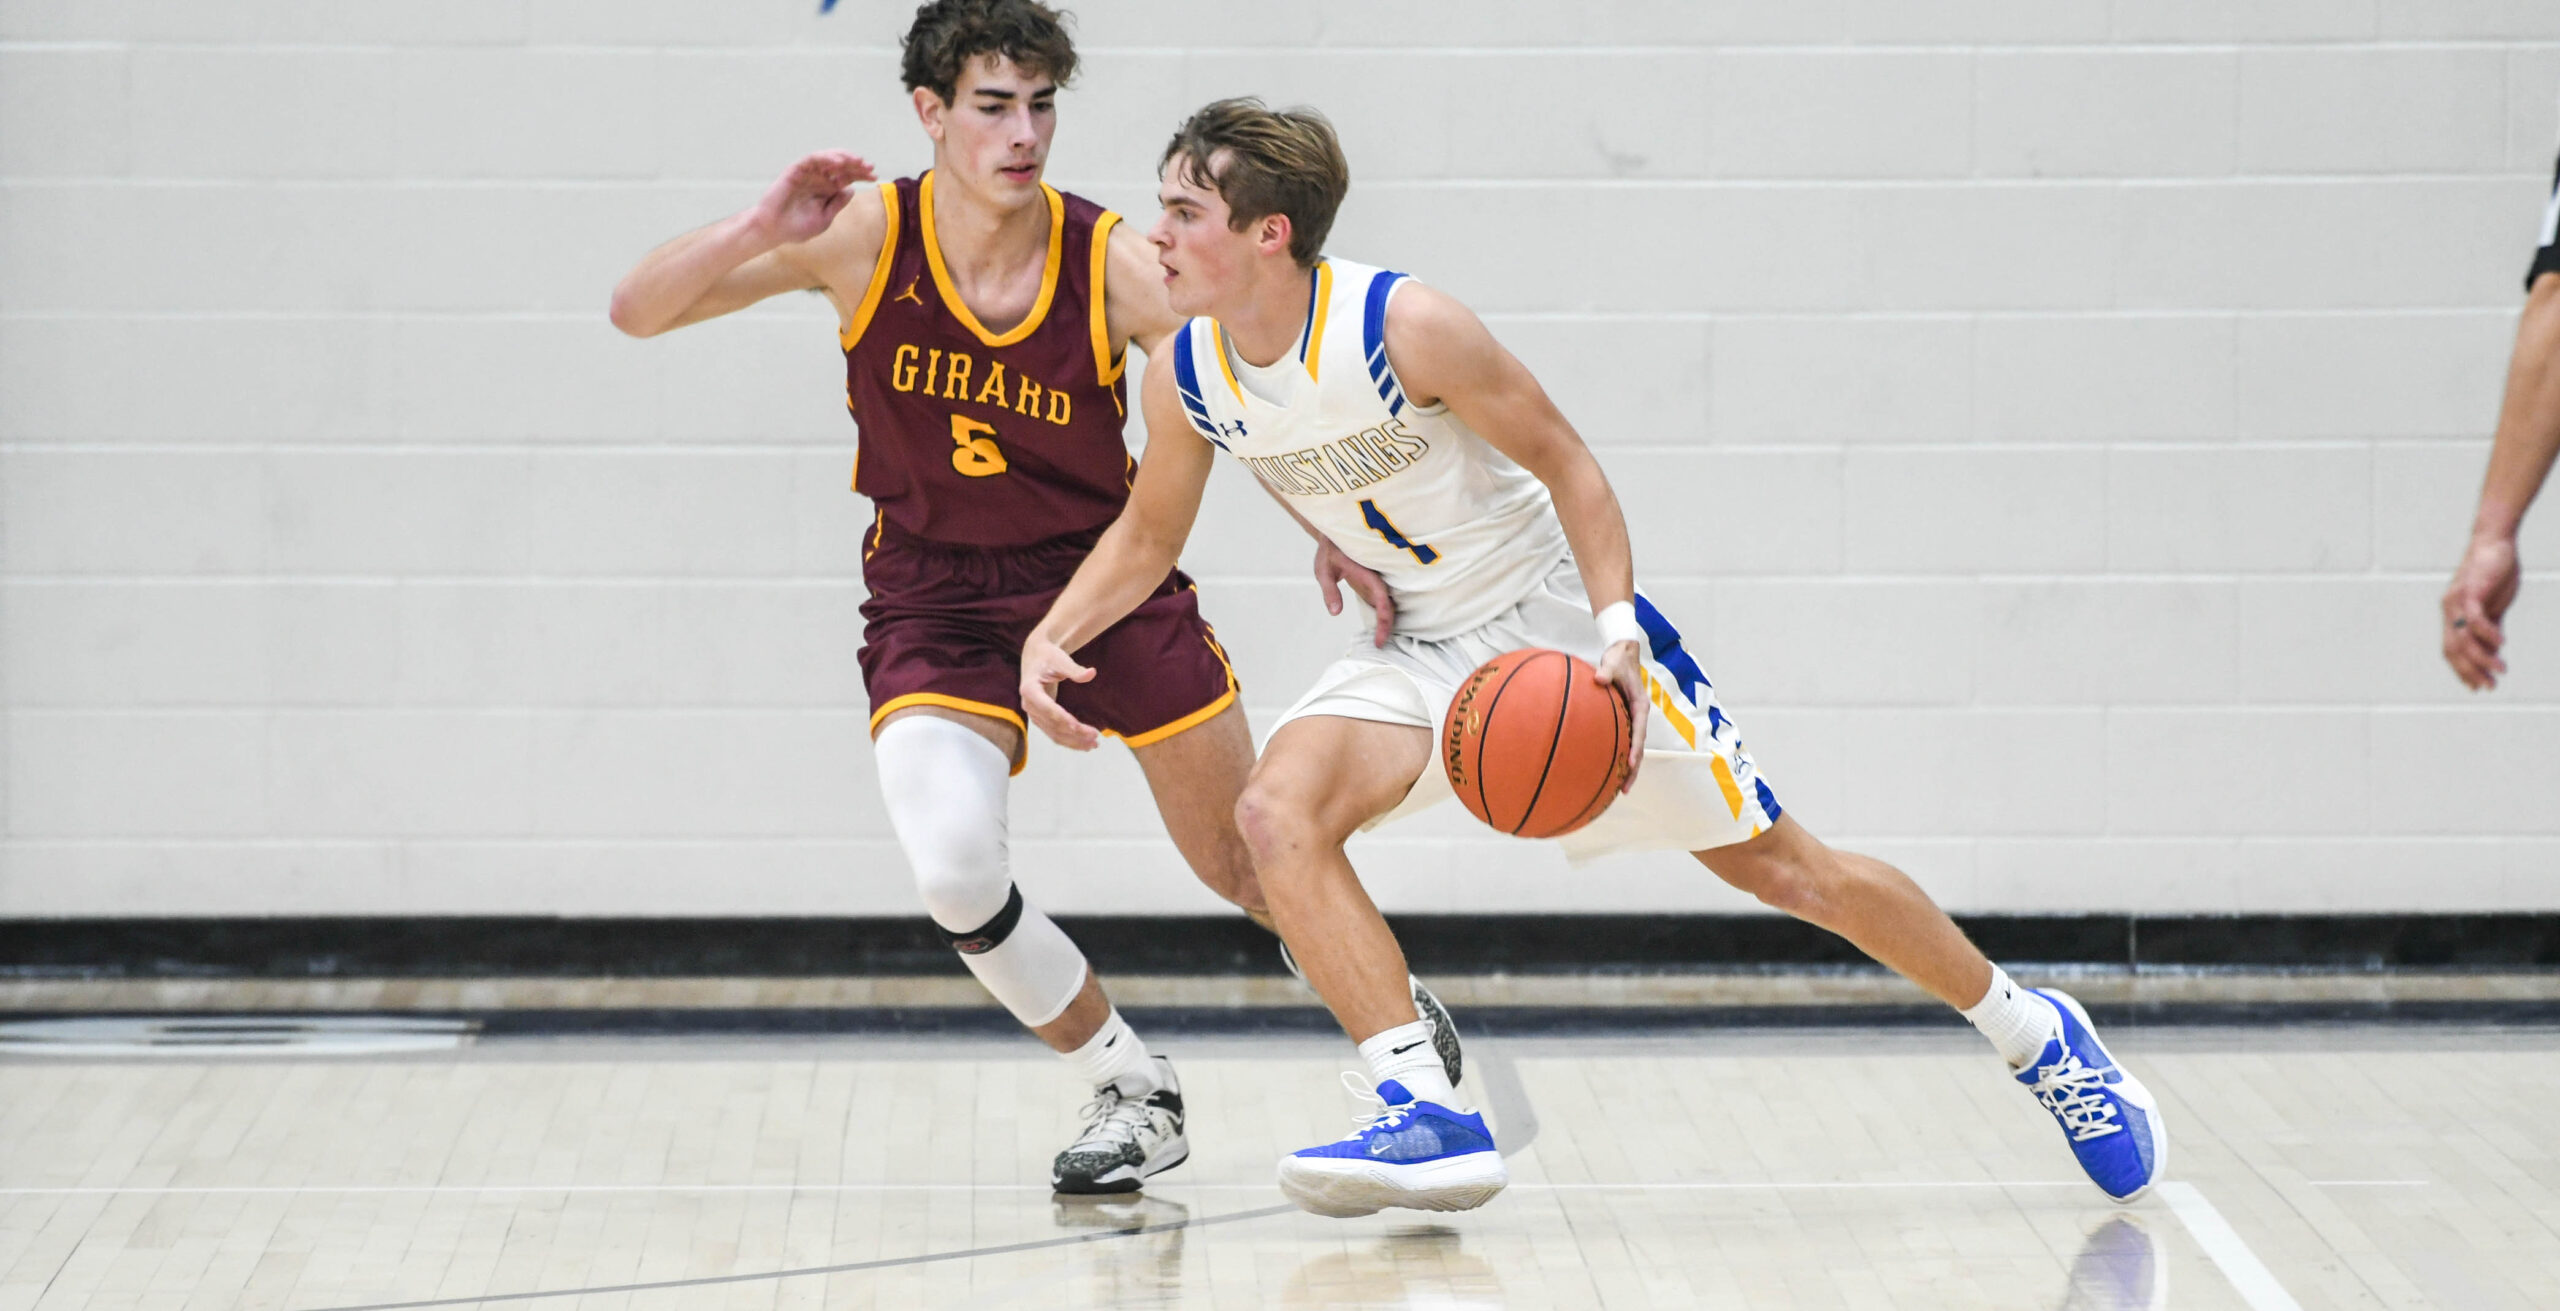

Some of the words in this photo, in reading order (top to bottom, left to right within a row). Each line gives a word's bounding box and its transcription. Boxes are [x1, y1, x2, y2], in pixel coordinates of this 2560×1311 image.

[892, 343, 1071, 425] GIRARD
[950, 413, 1008, 477] 5
[1356, 498, 1442, 566] 1
